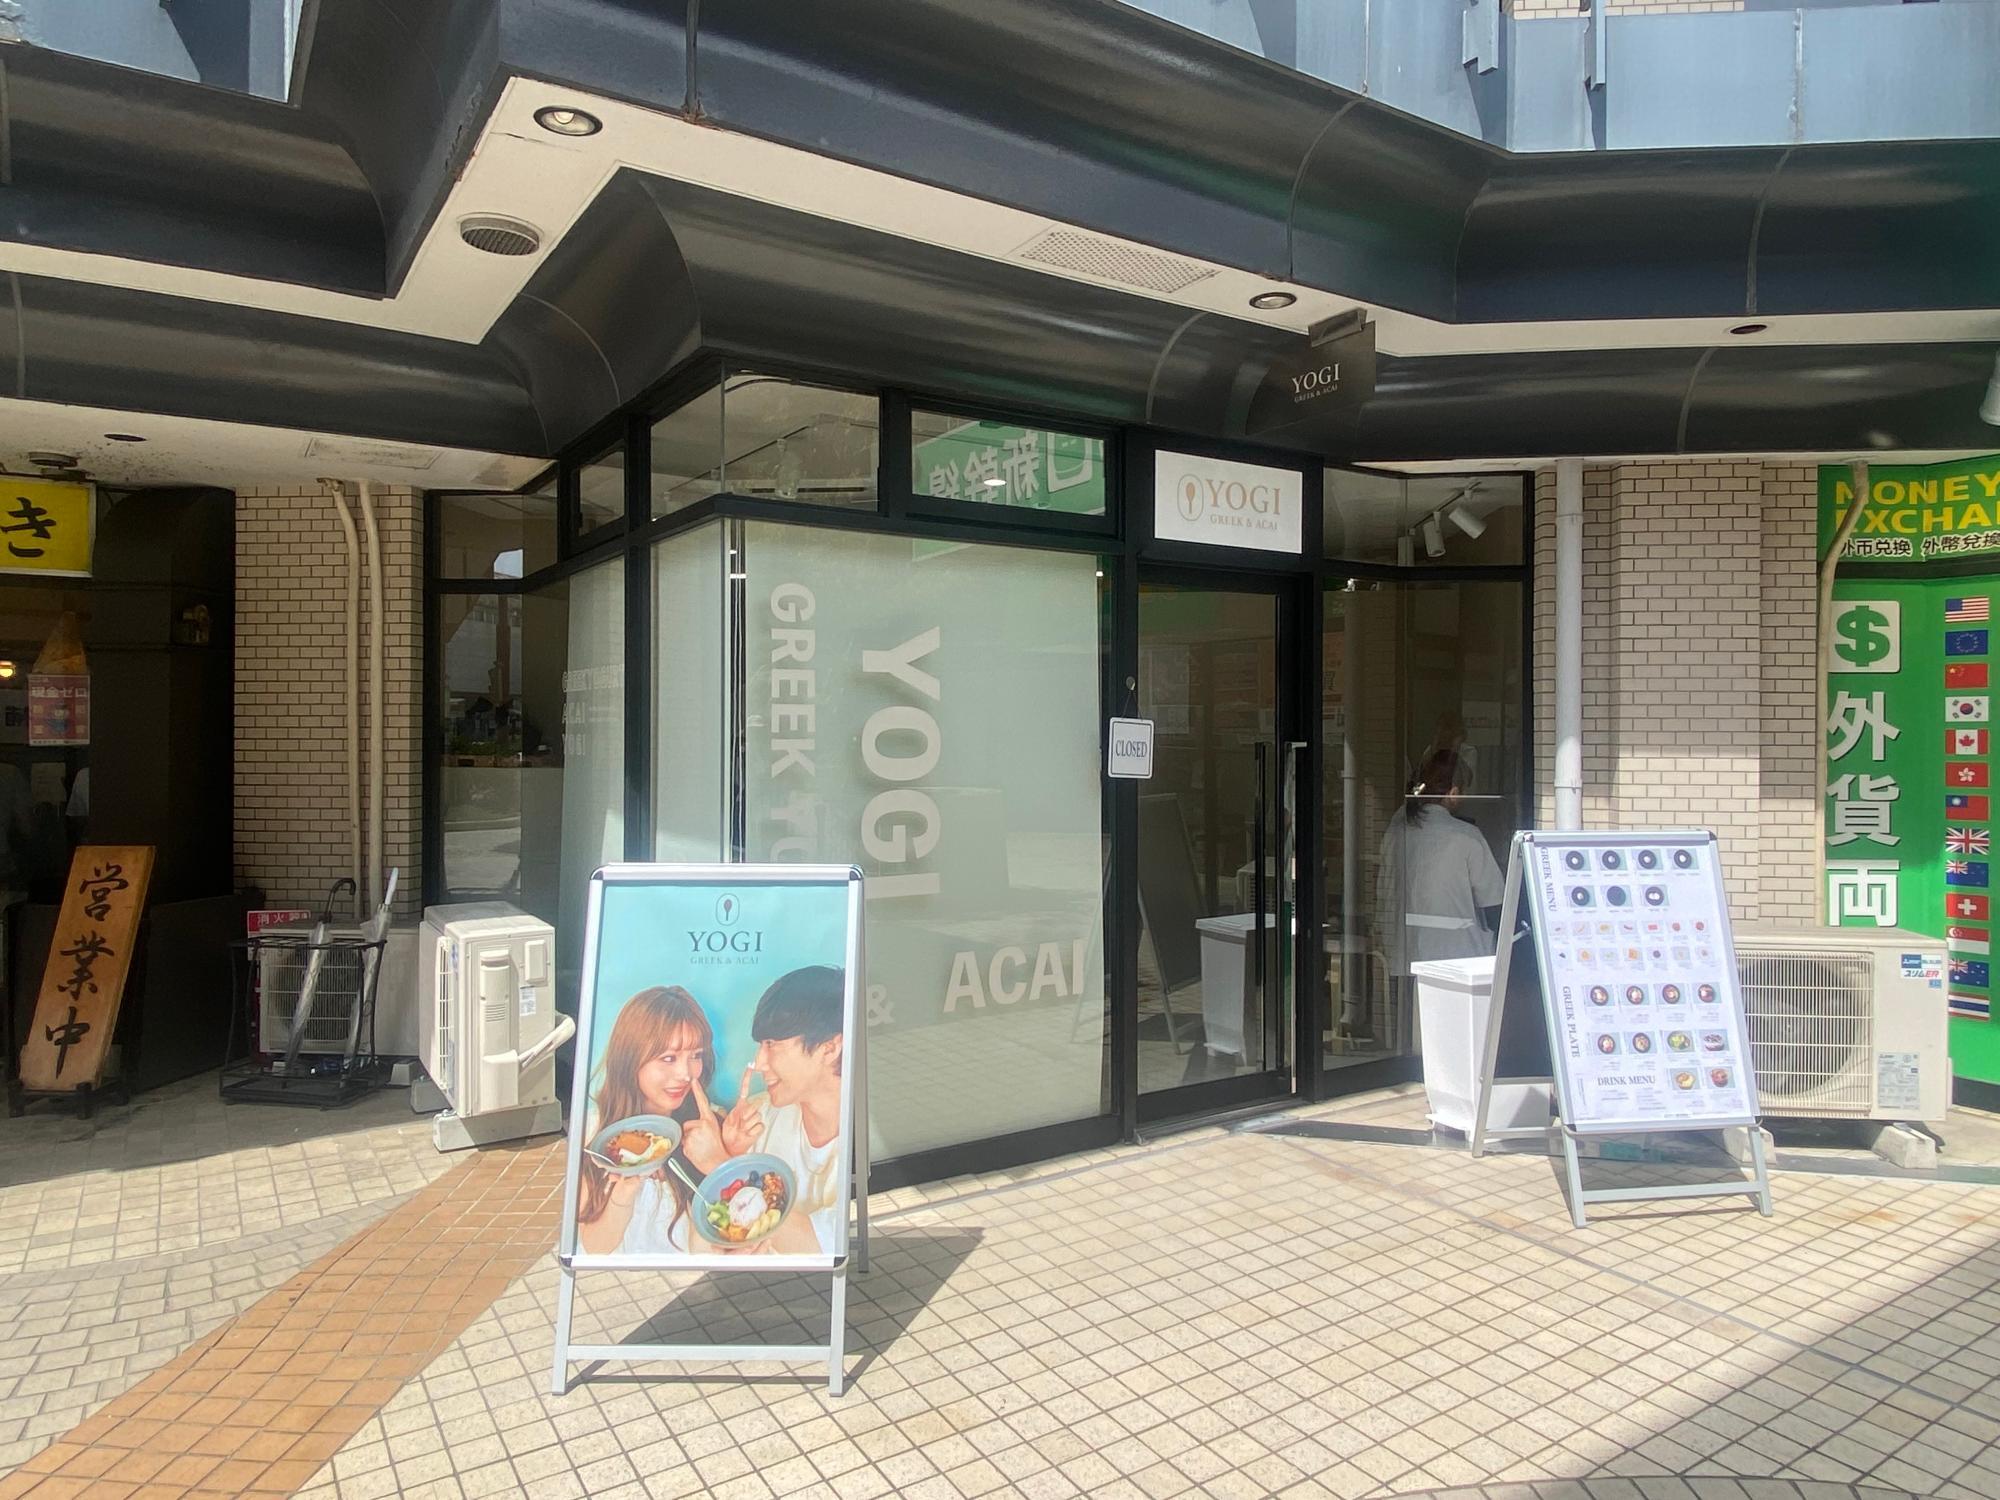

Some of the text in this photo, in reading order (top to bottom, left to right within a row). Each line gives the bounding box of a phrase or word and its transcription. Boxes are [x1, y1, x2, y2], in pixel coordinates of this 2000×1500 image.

[1292, 363, 1340, 393] YOGI
[1206, 479, 1280, 515] YOGI
[0, 497, 57, 557] き
[1210, 514, 1278, 530] GREEK & ACAI
[773, 583, 816, 778] GREEK
[861, 626, 941, 900] YOGI
[1116, 740, 1148, 757] CLOSED
[1541, 847, 1558, 912] GREEK MENU
[688, 931, 763, 953] YOGI
[45, 862, 129, 1079] 営業中
[867, 938, 1089, 1027] & ACAI
[1563, 986, 1575, 1020] GREEK
[1597, 1075, 1656, 1086] DRINK MENU
